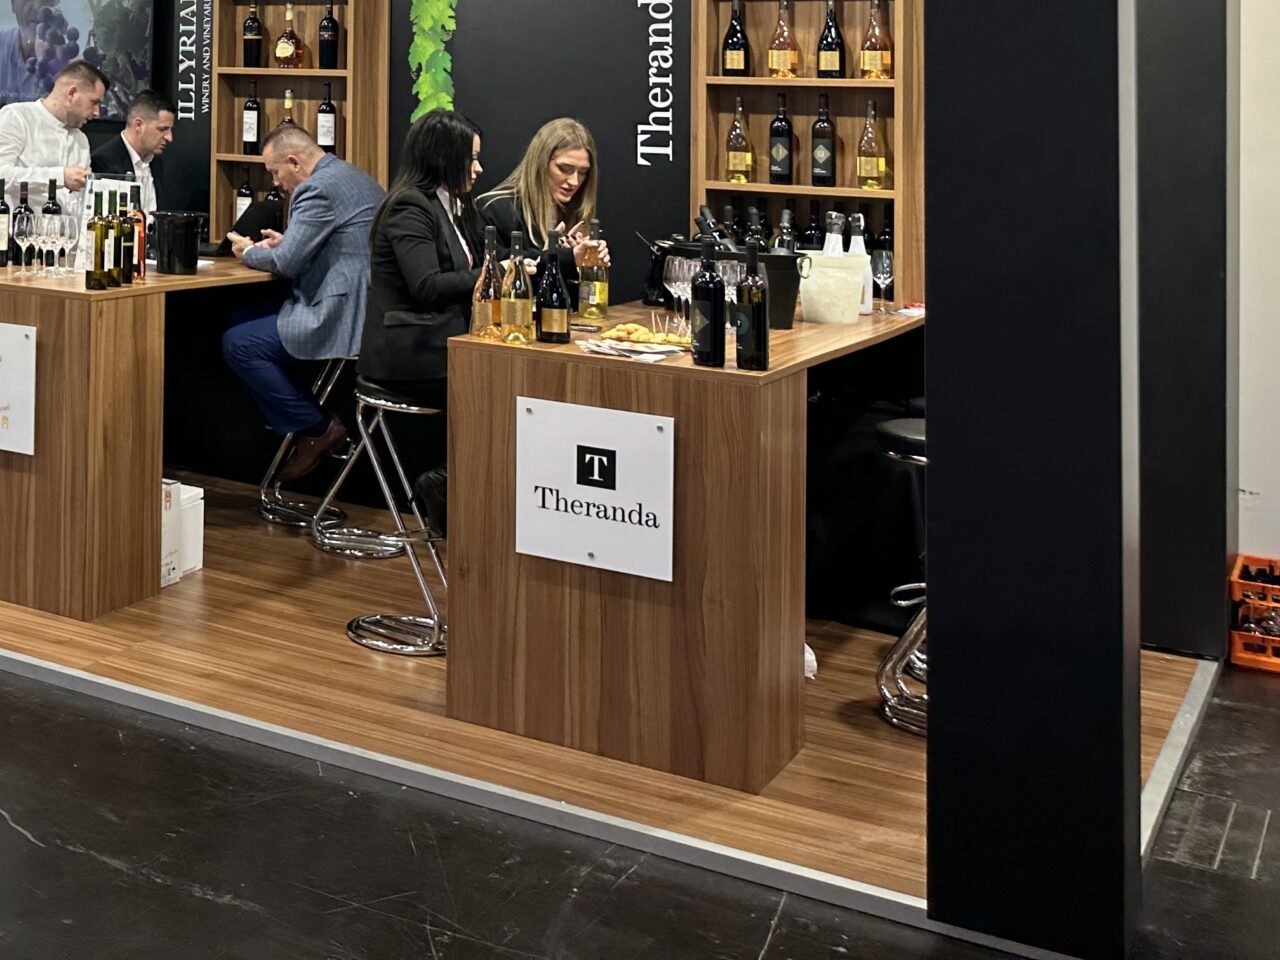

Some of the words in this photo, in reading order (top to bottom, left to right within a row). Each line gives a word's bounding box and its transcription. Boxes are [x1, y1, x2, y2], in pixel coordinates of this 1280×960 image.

[202, 46, 210, 71] AND
[201, 73, 210, 113] WINERY
[585, 453, 608, 482] T
[534, 485, 661, 529] Theranda
